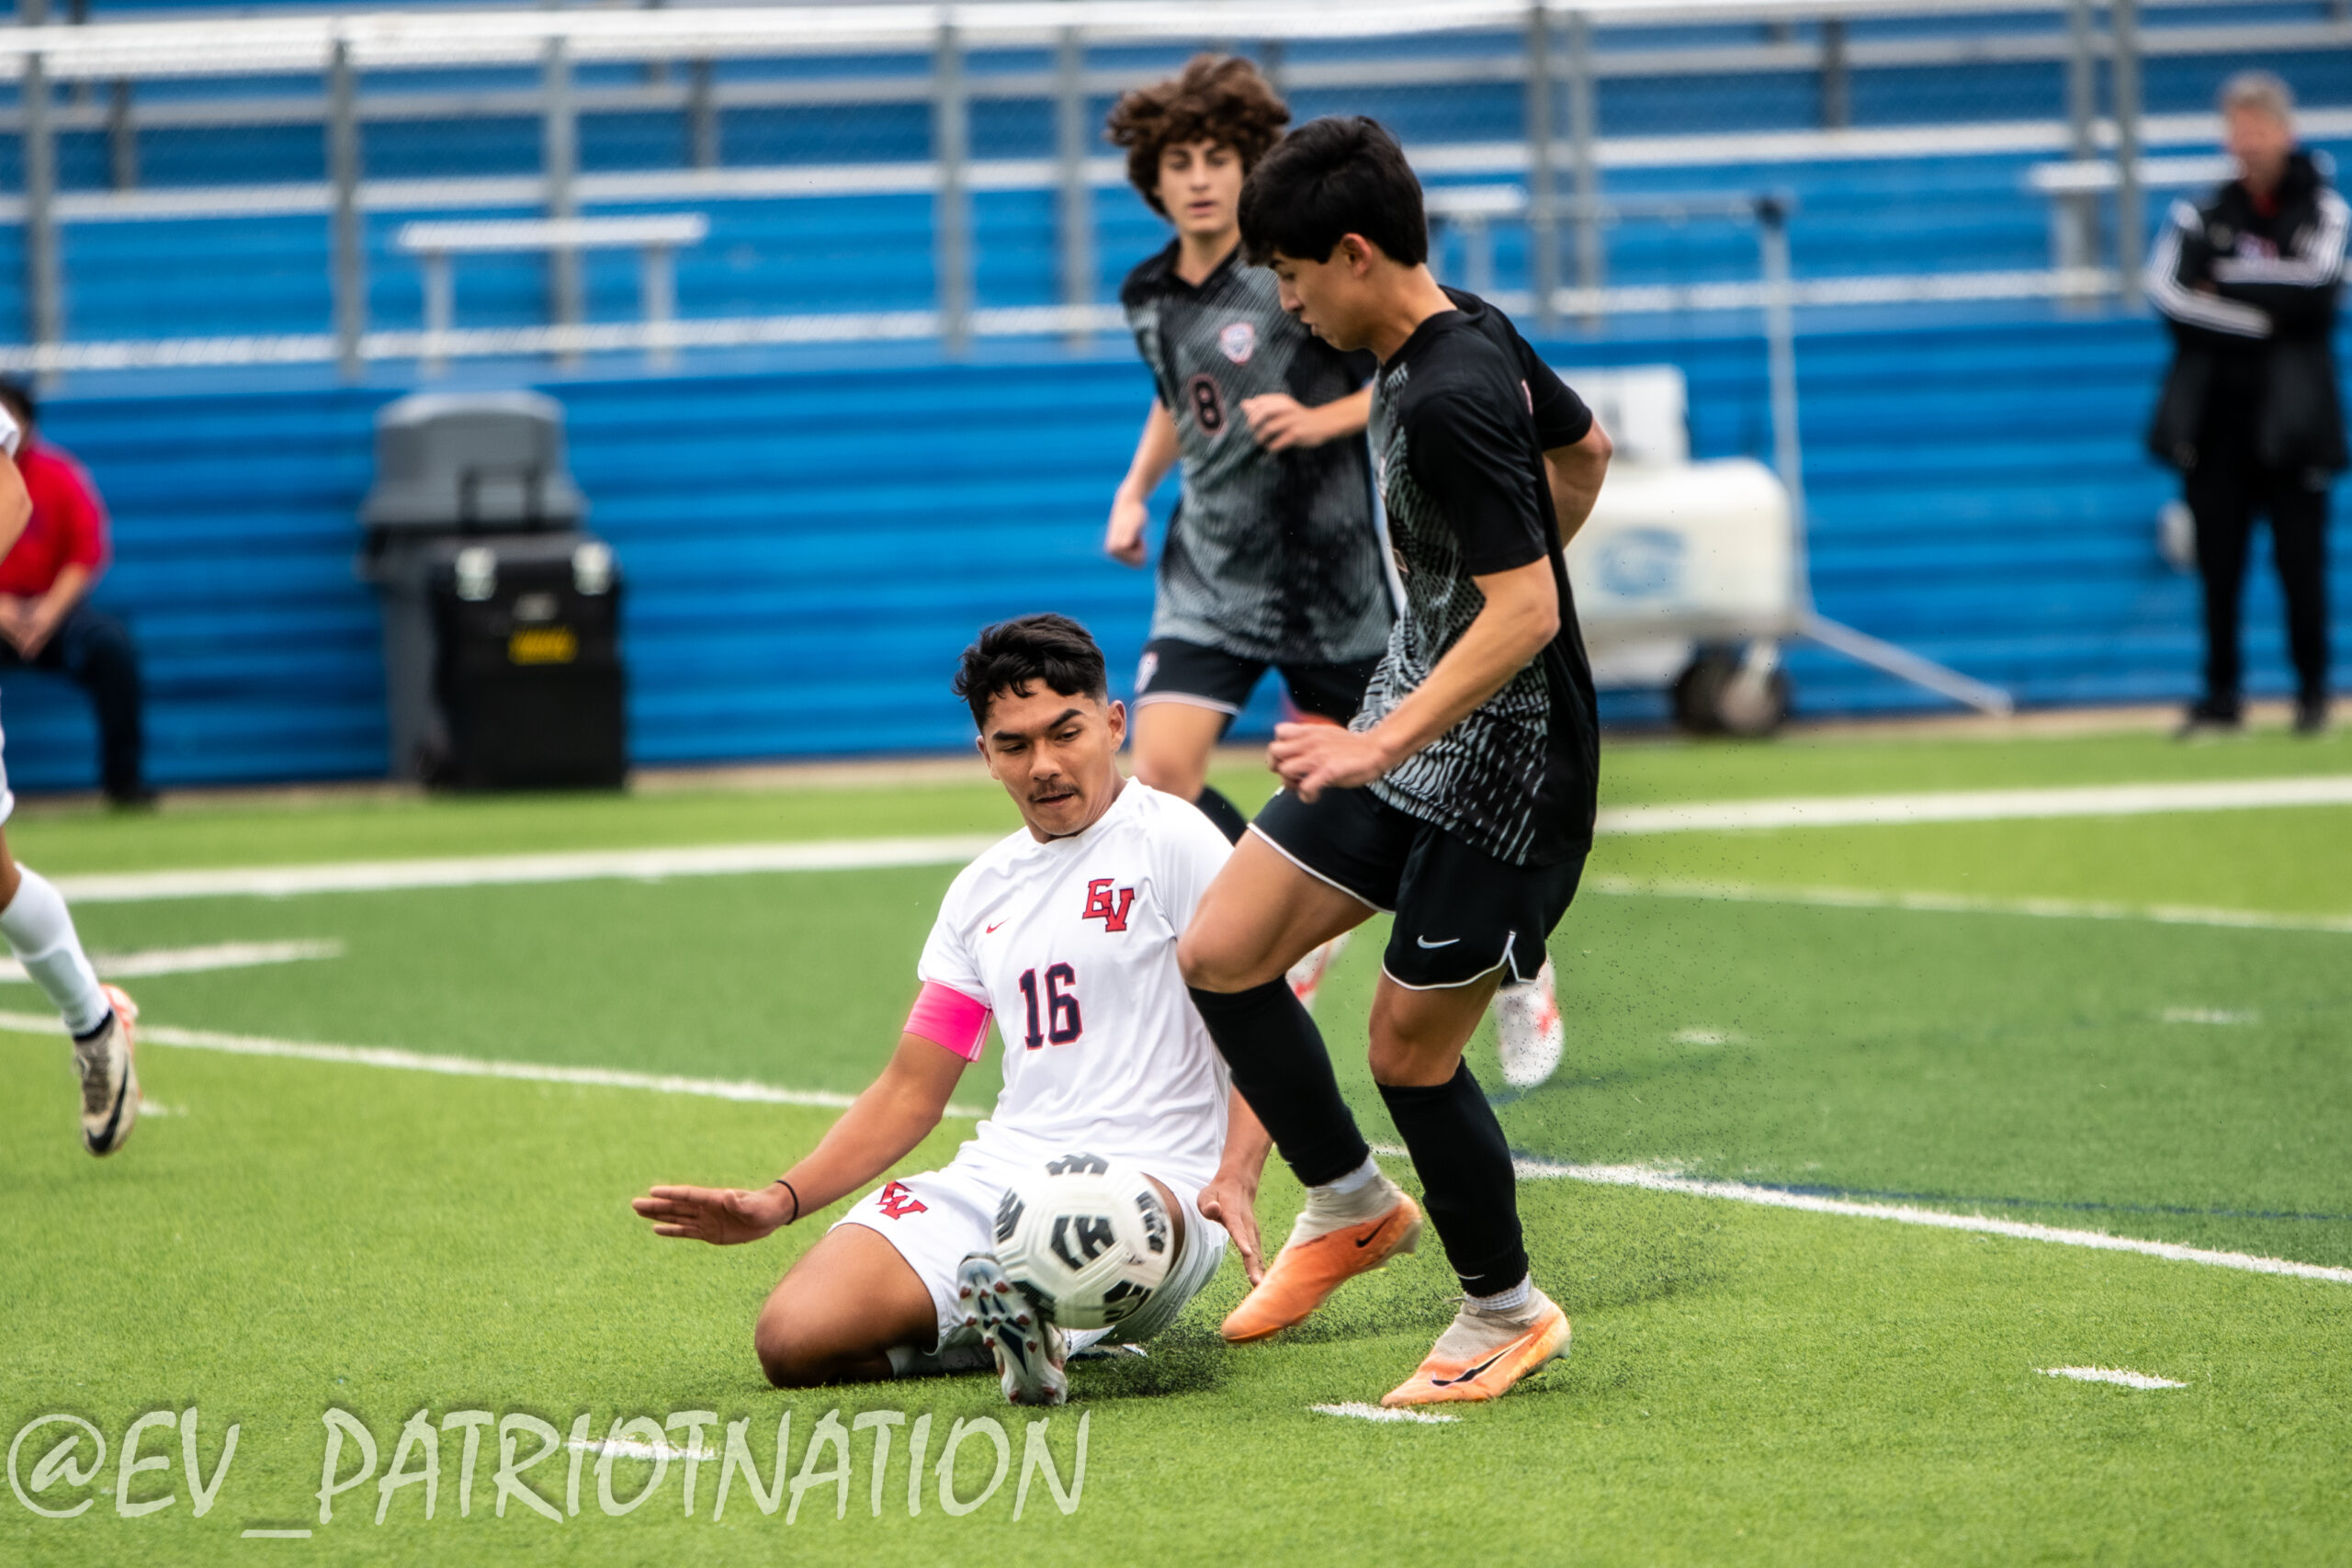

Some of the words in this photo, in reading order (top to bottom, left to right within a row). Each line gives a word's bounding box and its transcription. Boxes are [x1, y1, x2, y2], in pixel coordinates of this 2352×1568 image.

[1193, 376, 1223, 433] 8
[1082, 878, 1135, 932] EV
[1019, 962, 1083, 1051] 16
[875, 1180, 929, 1220] EV
